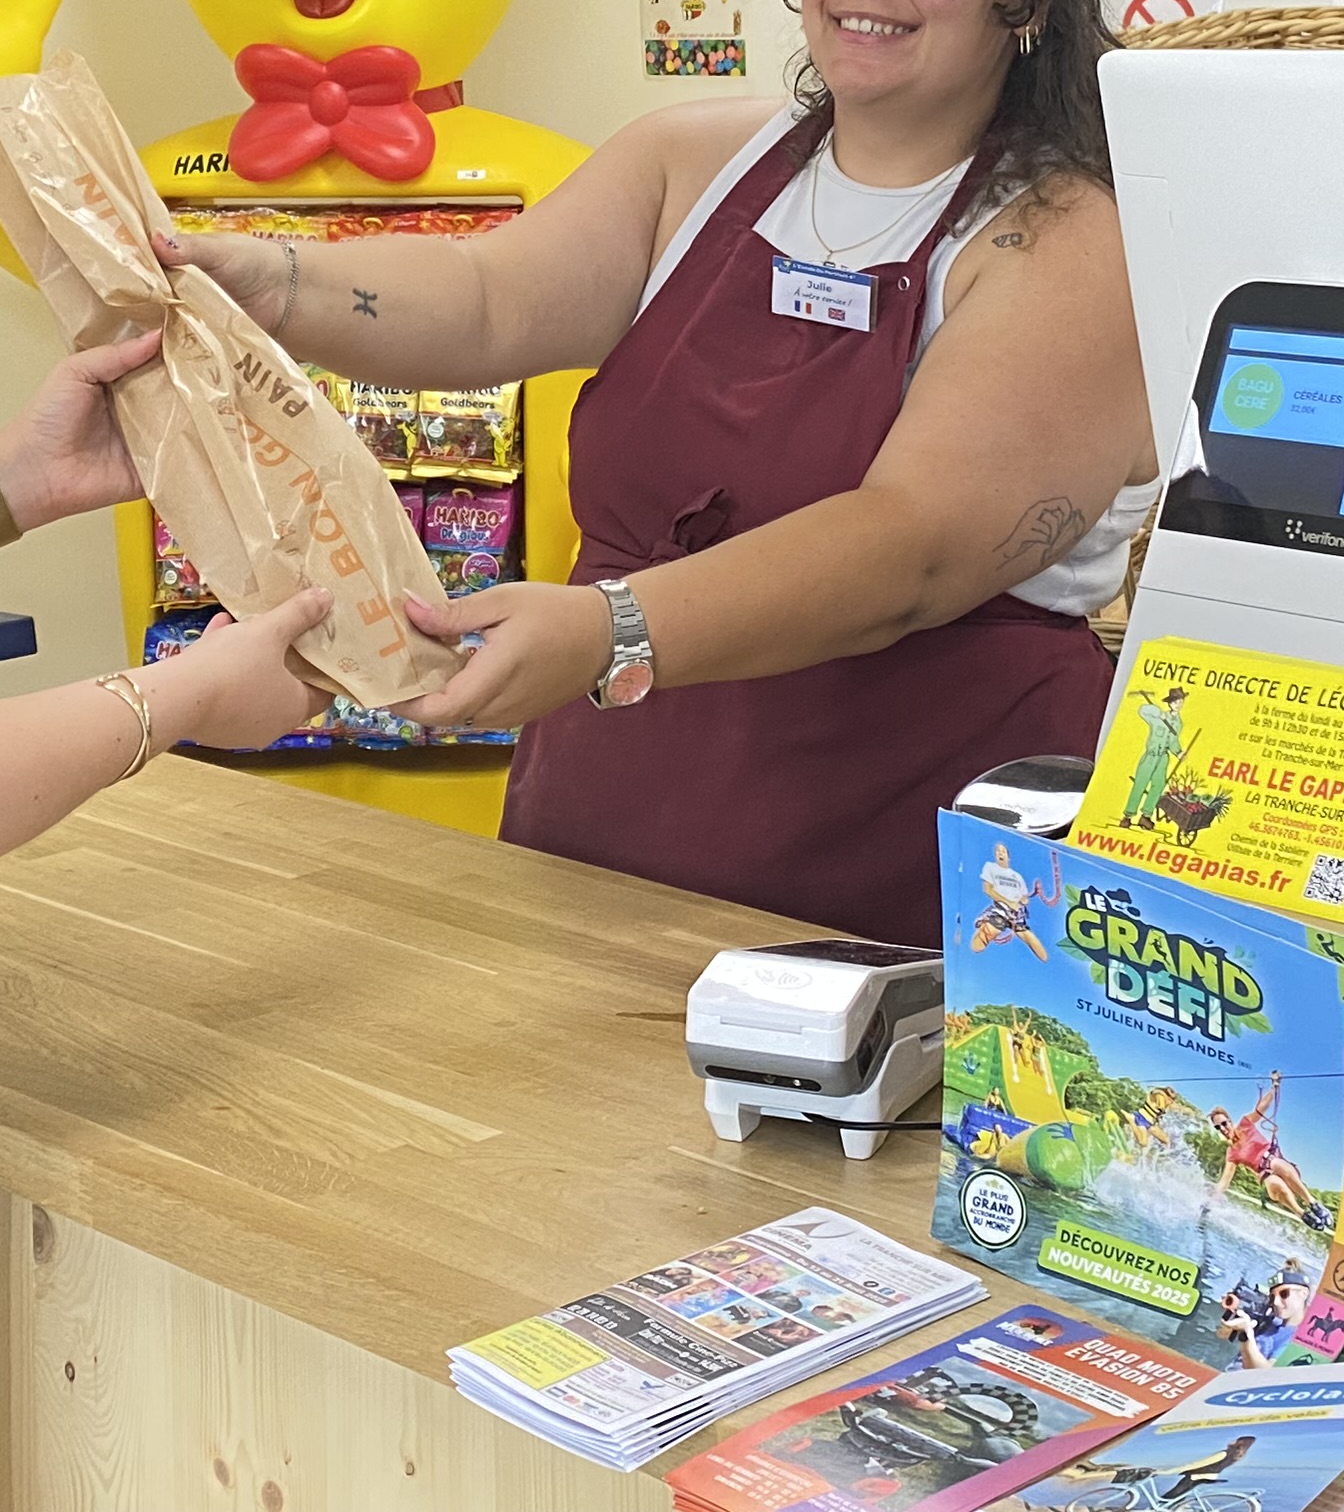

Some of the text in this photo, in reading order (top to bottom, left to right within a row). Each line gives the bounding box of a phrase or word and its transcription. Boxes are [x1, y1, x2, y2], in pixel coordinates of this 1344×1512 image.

[807, 280, 832, 293] Julie
[234, 353, 308, 418] PAIN
[1238, 377, 1274, 393] BAGU
[1294, 390, 1343, 404] CÉRÉALES
[441, 397, 495, 409] Goldbears
[435, 506, 500, 528] HARIBO
[289, 470, 407, 658] LE BON
[1144, 658, 1200, 684] VENTE
[1205, 670, 1280, 699] DIRECTE
[1287, 683, 1308, 704] DE
[1250, 716, 1261, 726] de
[1261, 718, 1273, 728] 9h
[1282, 721, 1308, 735] 12h30
[1309, 727, 1318, 737] et
[1320, 729, 1331, 739] de
[1261, 705, 1269, 715] la
[1270, 707, 1296, 721] ferme
[1297, 712, 1309, 723] du
[1310, 714, 1330, 726] lundi
[1332, 720, 1343, 729] au
[1238, 731, 1248, 740] et
[1249, 734, 1263, 743] sur
[1265, 736, 1277, 746] les
[1278, 738, 1315, 753] marchés
[1316, 745, 1327, 755] de
[1328, 748, 1337, 757] la
[1262, 748, 1343, 772] La Tranche-sur-Mer
[1208, 756, 1260, 787] EARL
[1268, 769, 1291, 793] LE
[1245, 791, 1260, 807] LA
[1262, 812, 1338, 836] Coordonnées GPS
[1230, 833, 1258, 846] Chemin
[1260, 839, 1269, 848] de
[1270, 841, 1277, 850] la
[1077, 827, 1291, 893] www.legapias.fr
[1253, 849, 1263, 858] de
[1264, 852, 1271, 860] la
[1085, 892, 1107, 912] LE
[1068, 908, 1261, 1010] GRAND
[1107, 959, 1223, 1040] DÉFI
[1076, 998, 1234, 1066] ST JULIEN DES LANDES
[972, 1196, 1014, 1216] GRAND
[991, 1191, 1008, 1201] PLUS
[973, 1216, 1010, 1233] DU MONDE
[1061, 1226, 1192, 1286] DÉCOUVREZ NOS
[1048, 1247, 1191, 1307] NOUVEAUTÉS 2025
[1064, 1347, 1153, 1386] EVASION
[1083, 1339, 1197, 1388] QUAD MOTO
